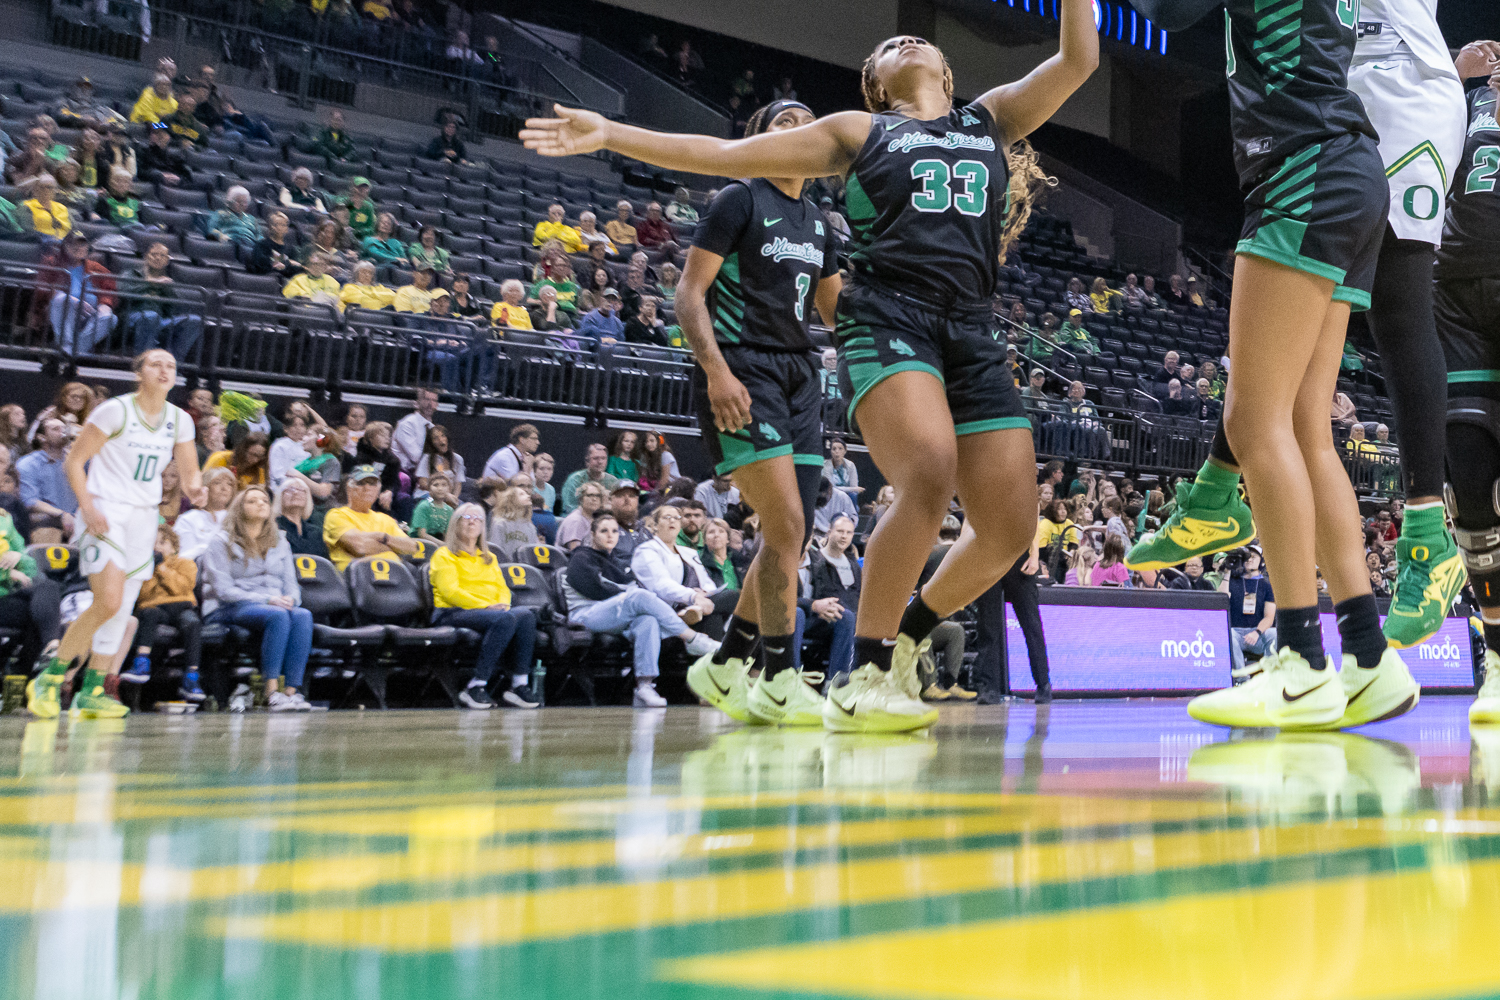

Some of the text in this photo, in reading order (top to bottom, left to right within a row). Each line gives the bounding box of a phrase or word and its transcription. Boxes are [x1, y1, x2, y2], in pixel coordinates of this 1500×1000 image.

[910, 158, 990, 217] 33
[1402, 184, 1440, 220] O
[794, 272, 811, 322] 3
[133, 453, 159, 482] 10
[1161, 635, 1216, 658] moda
[1419, 640, 1461, 660] moda
